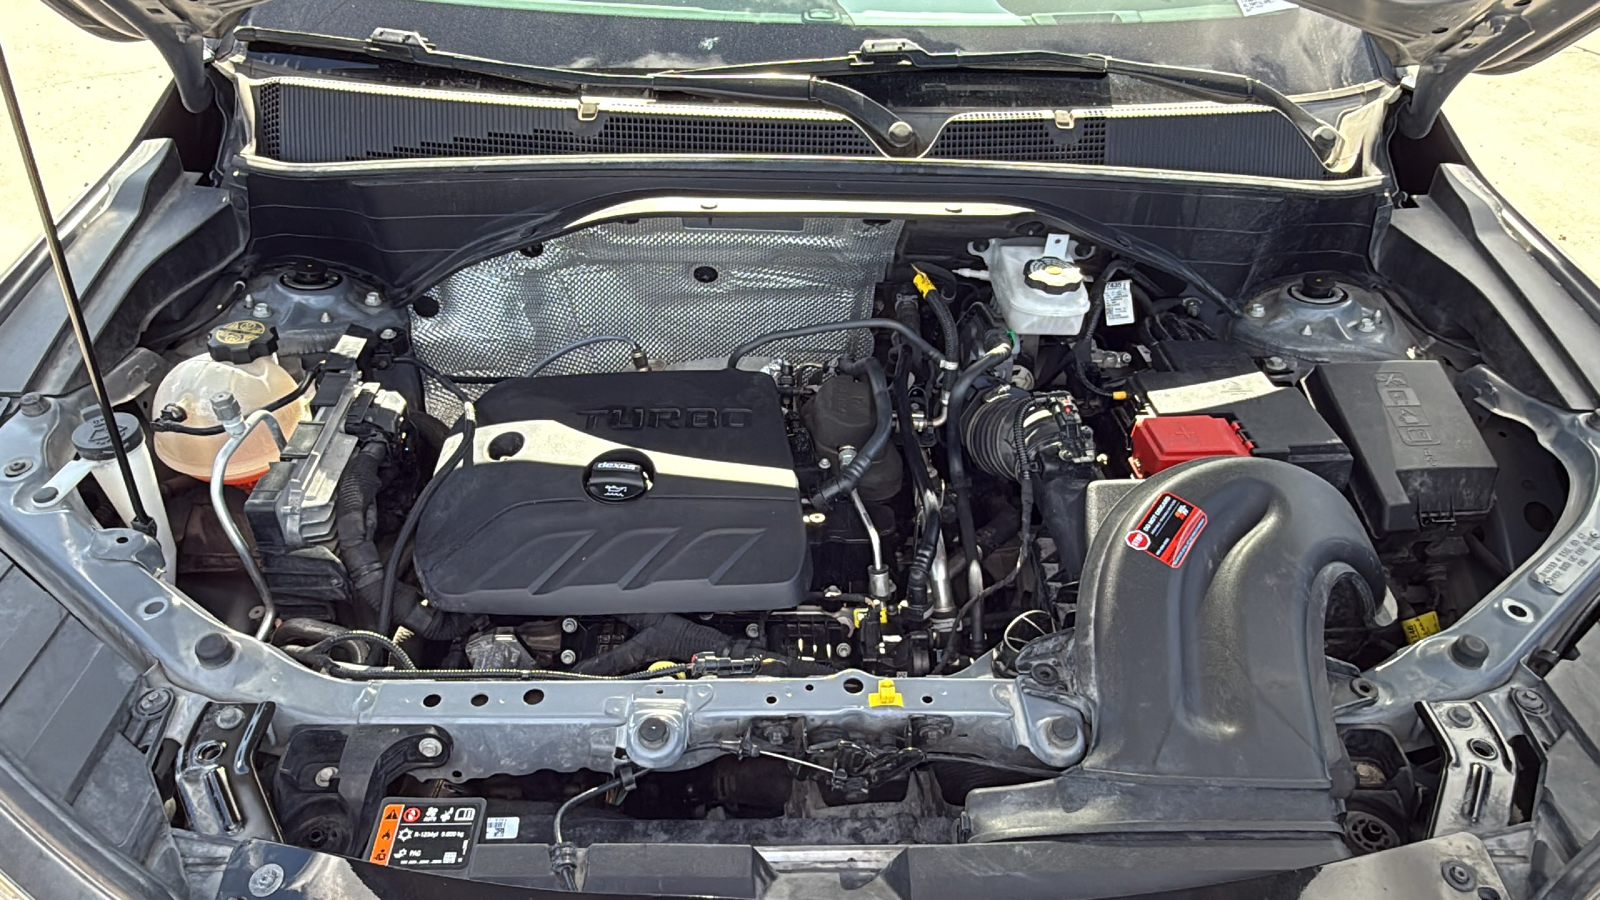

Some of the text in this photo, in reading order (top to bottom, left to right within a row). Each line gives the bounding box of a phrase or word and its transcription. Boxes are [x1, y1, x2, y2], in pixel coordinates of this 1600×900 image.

[577, 406, 753, 430] TURBO
[597, 461, 637, 471] dexos
[1143, 495, 1171, 532] DO NOT DISCARD
[1131, 533, 1143, 547] STOP
